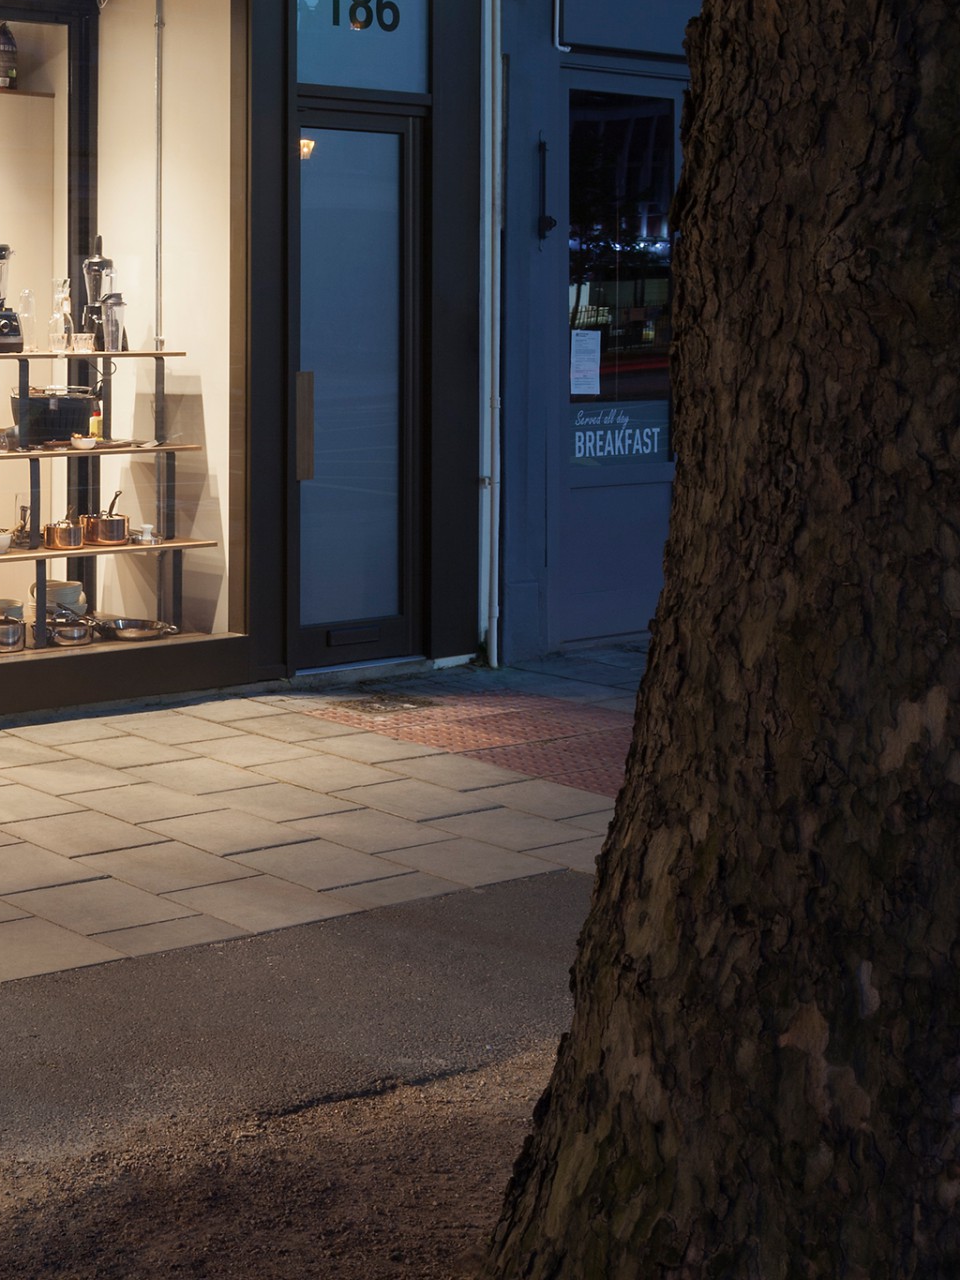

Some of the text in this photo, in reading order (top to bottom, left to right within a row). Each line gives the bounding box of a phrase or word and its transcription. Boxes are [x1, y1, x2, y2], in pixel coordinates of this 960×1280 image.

[575, 408, 630, 430] Served all day
[575, 428, 661, 458] BREAKFAST
